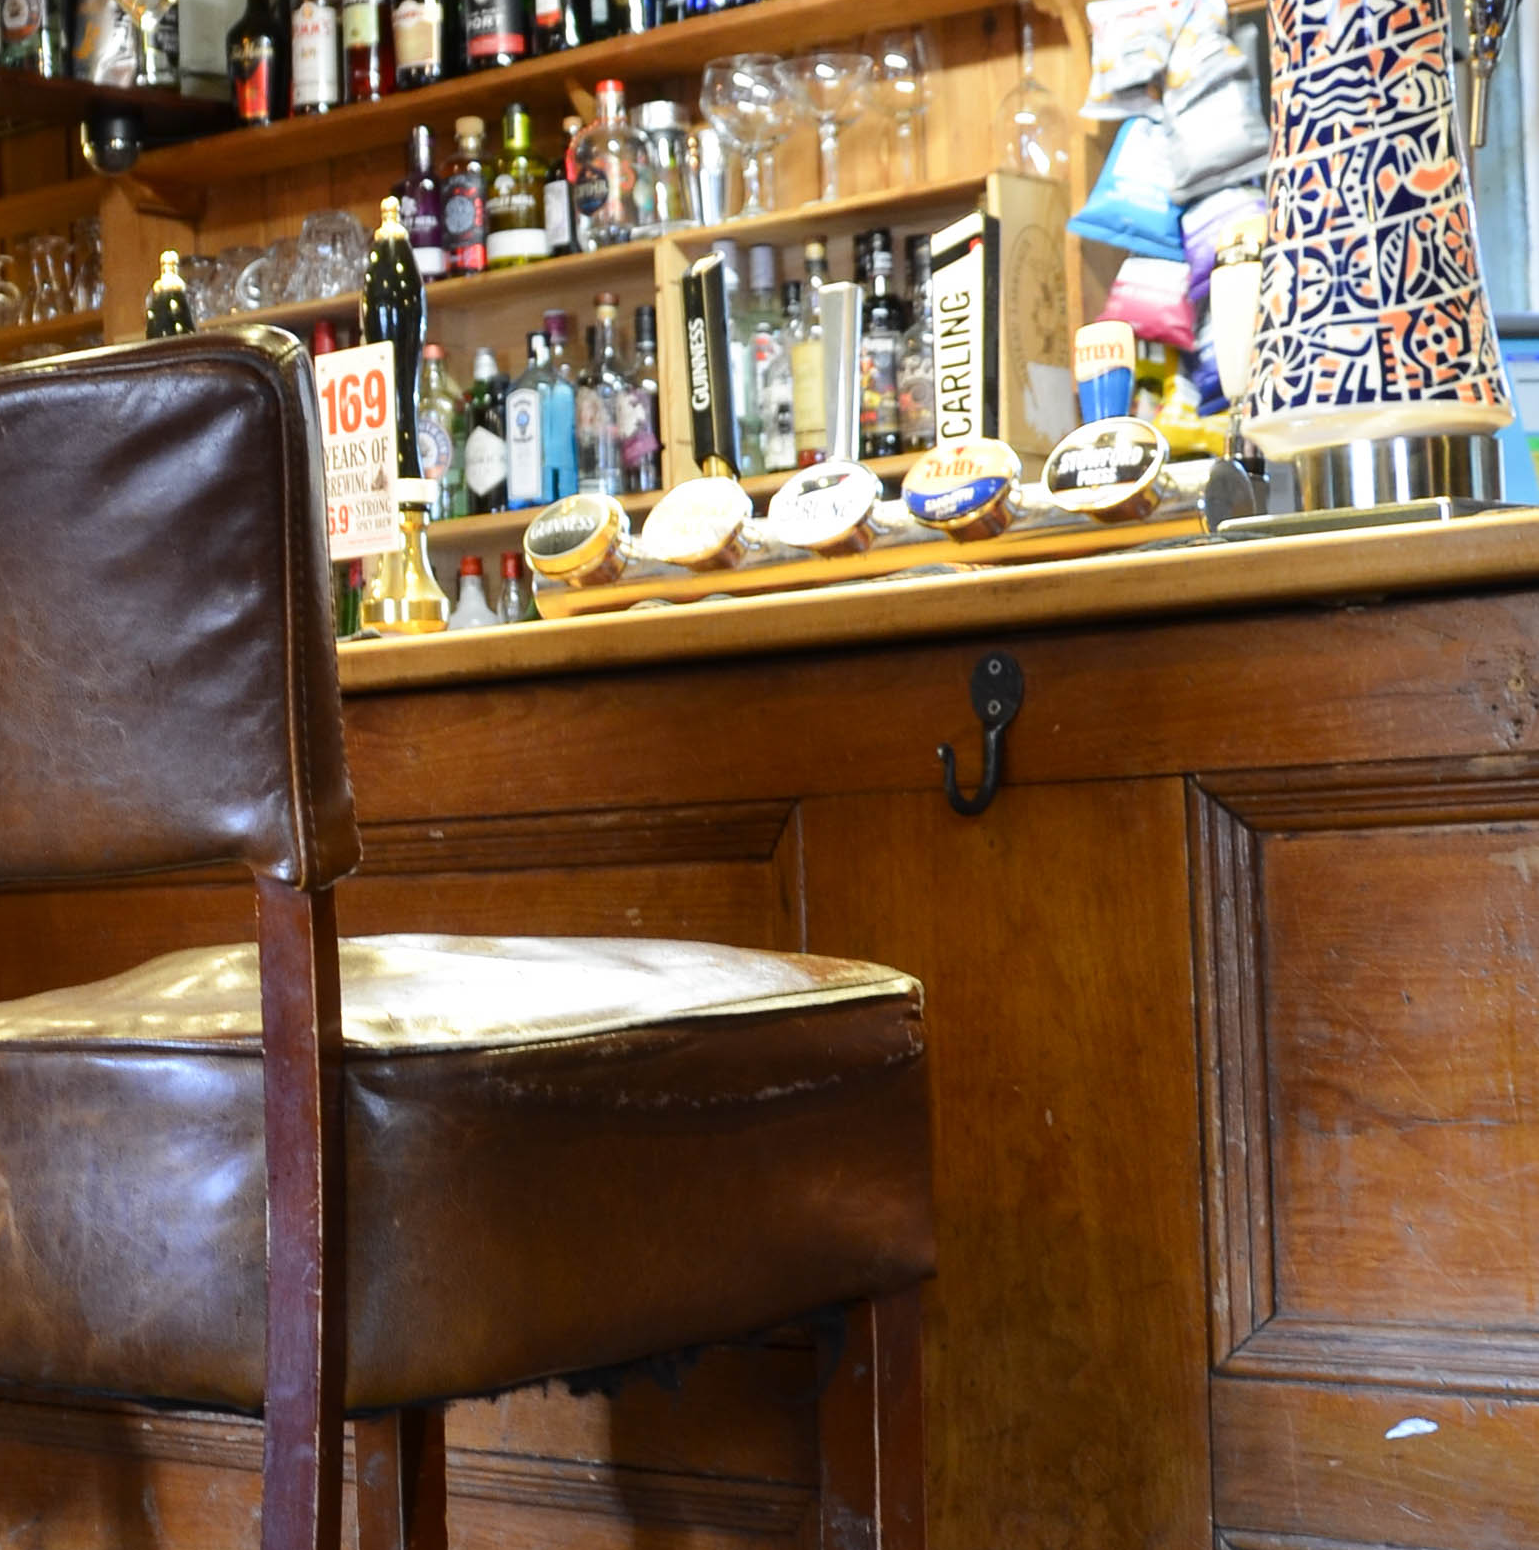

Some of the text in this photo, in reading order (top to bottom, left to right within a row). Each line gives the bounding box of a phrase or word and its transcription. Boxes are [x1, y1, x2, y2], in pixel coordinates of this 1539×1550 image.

[688, 316, 710, 412] GUINNESS
[940, 289, 972, 439] CARLING
[321, 369, 387, 436] 169
[324, 440, 367, 473] YEARS
[371, 437, 389, 465] OF
[356, 499, 392, 518] STRONG
[531, 514, 596, 540] GUINNESS
